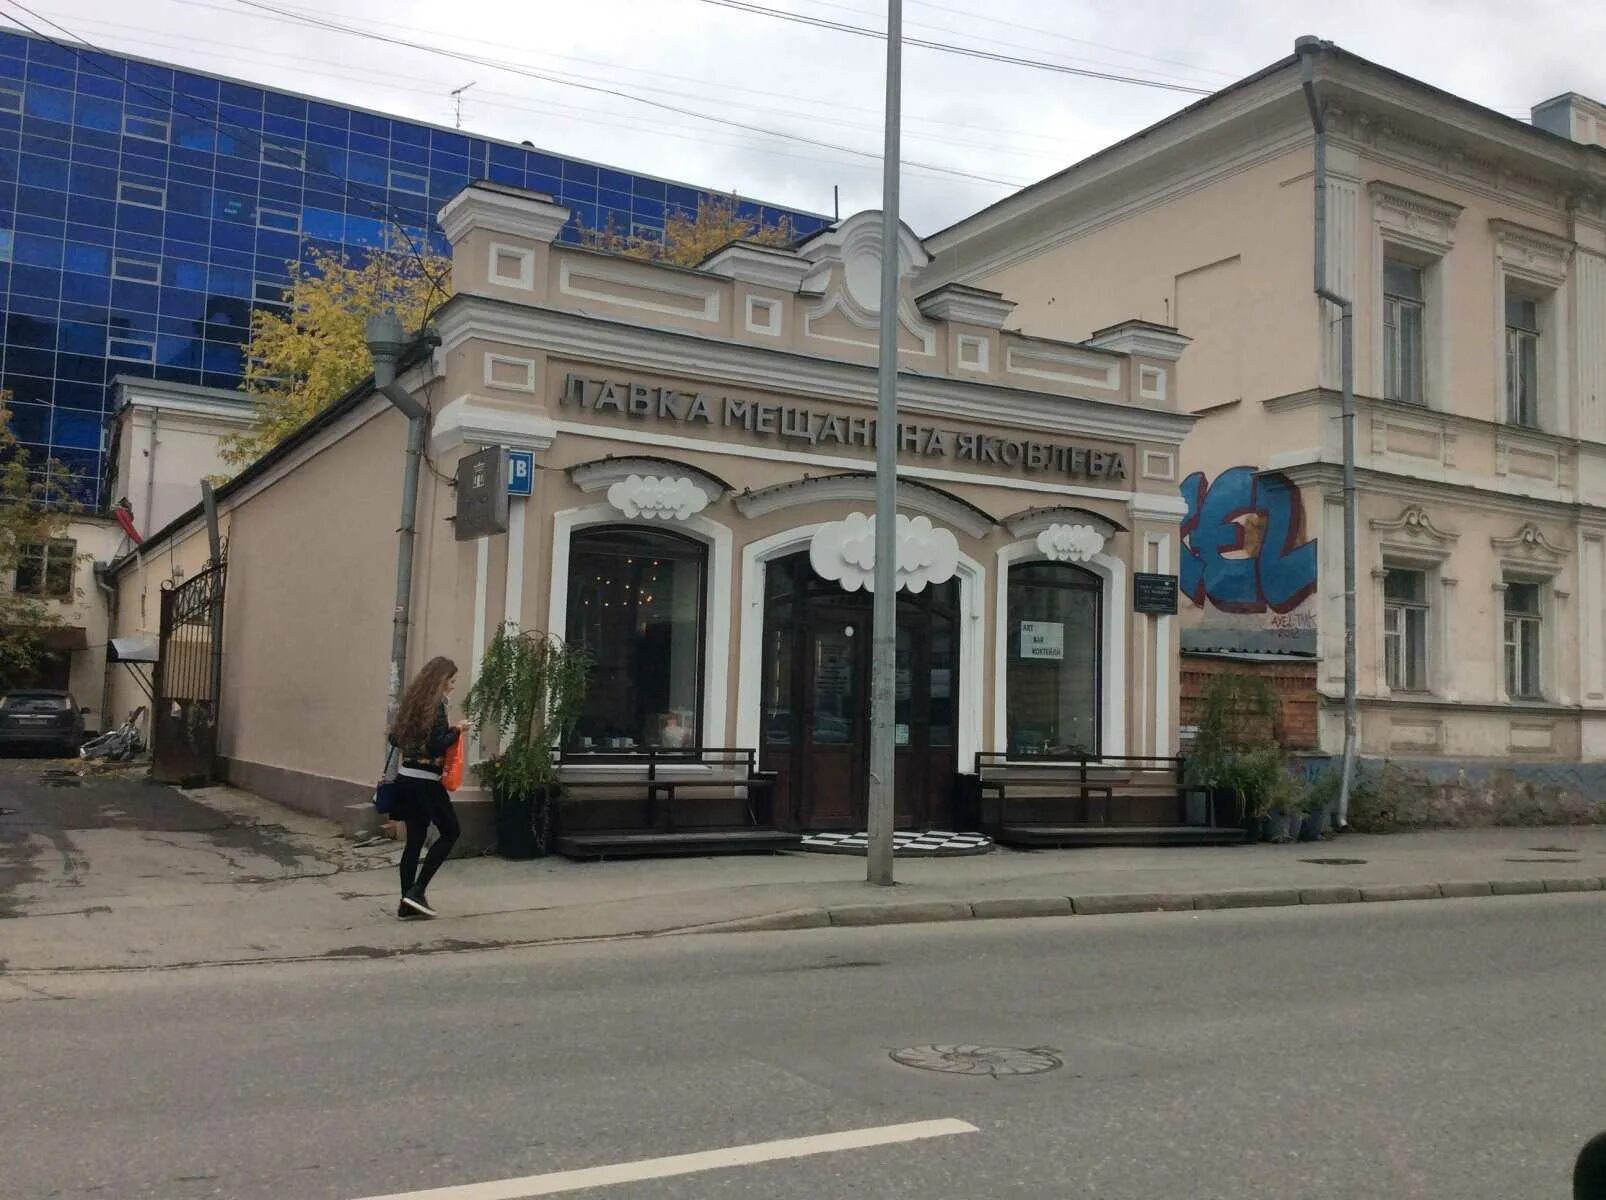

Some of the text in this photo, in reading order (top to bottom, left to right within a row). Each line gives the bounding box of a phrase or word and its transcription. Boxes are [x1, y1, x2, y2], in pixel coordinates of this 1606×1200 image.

[562, 373, 1127, 479] ЛАВКА МЕЩАННА ЯКОВЛЕВА
